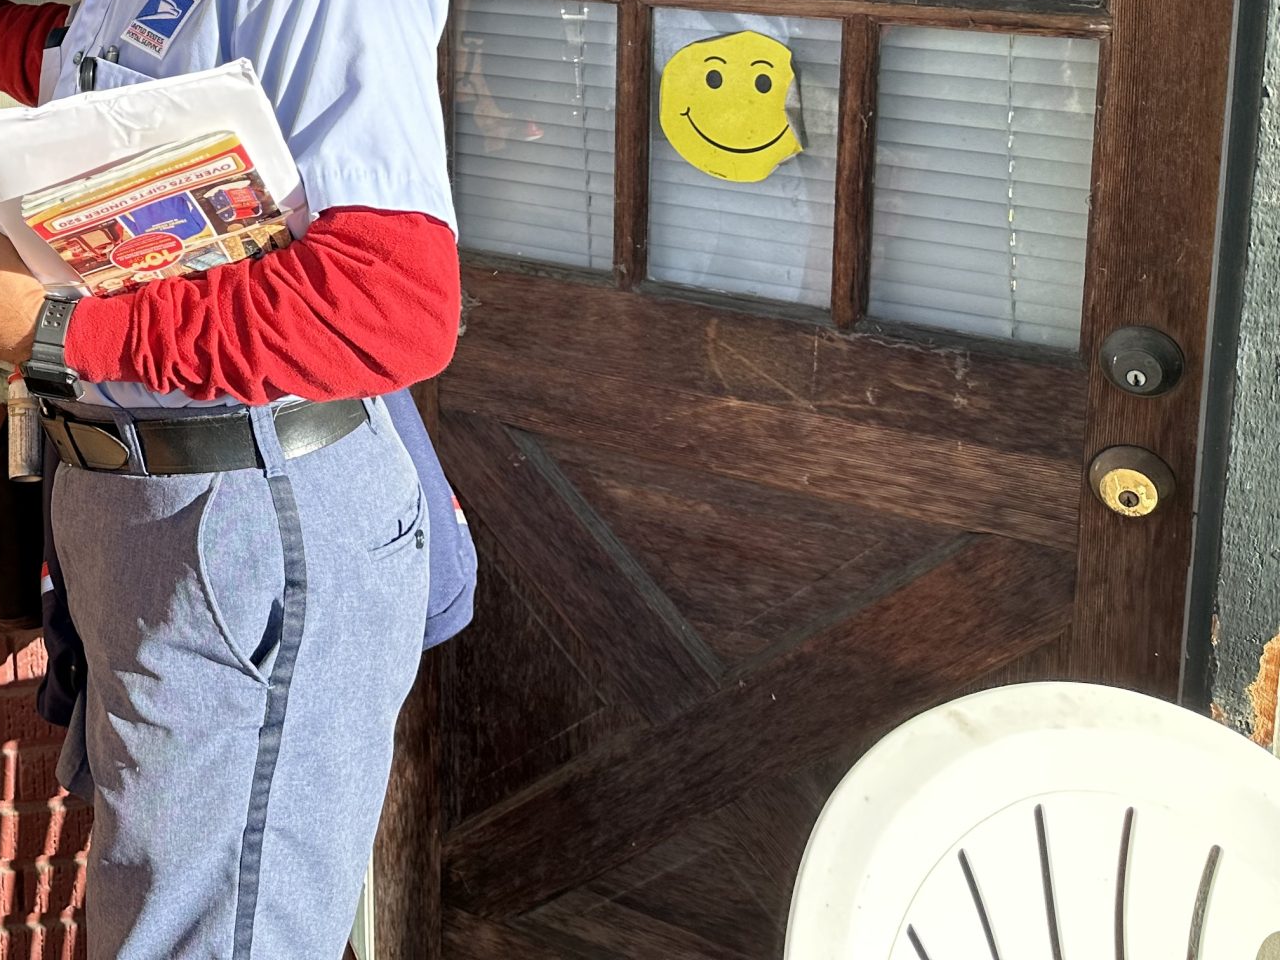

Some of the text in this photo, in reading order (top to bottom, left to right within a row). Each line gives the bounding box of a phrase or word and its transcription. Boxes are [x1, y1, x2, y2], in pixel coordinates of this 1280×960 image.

[126, 30, 163, 54] POSTAL SERVICE
[130, 23, 165, 44] UNITED STATES
[195, 163, 231, 179] OVER
[169, 175, 193, 187] 275
[129, 184, 168, 201] GIFTS
[85, 200, 129, 219] UNDER
[58, 217, 82, 228] $20
